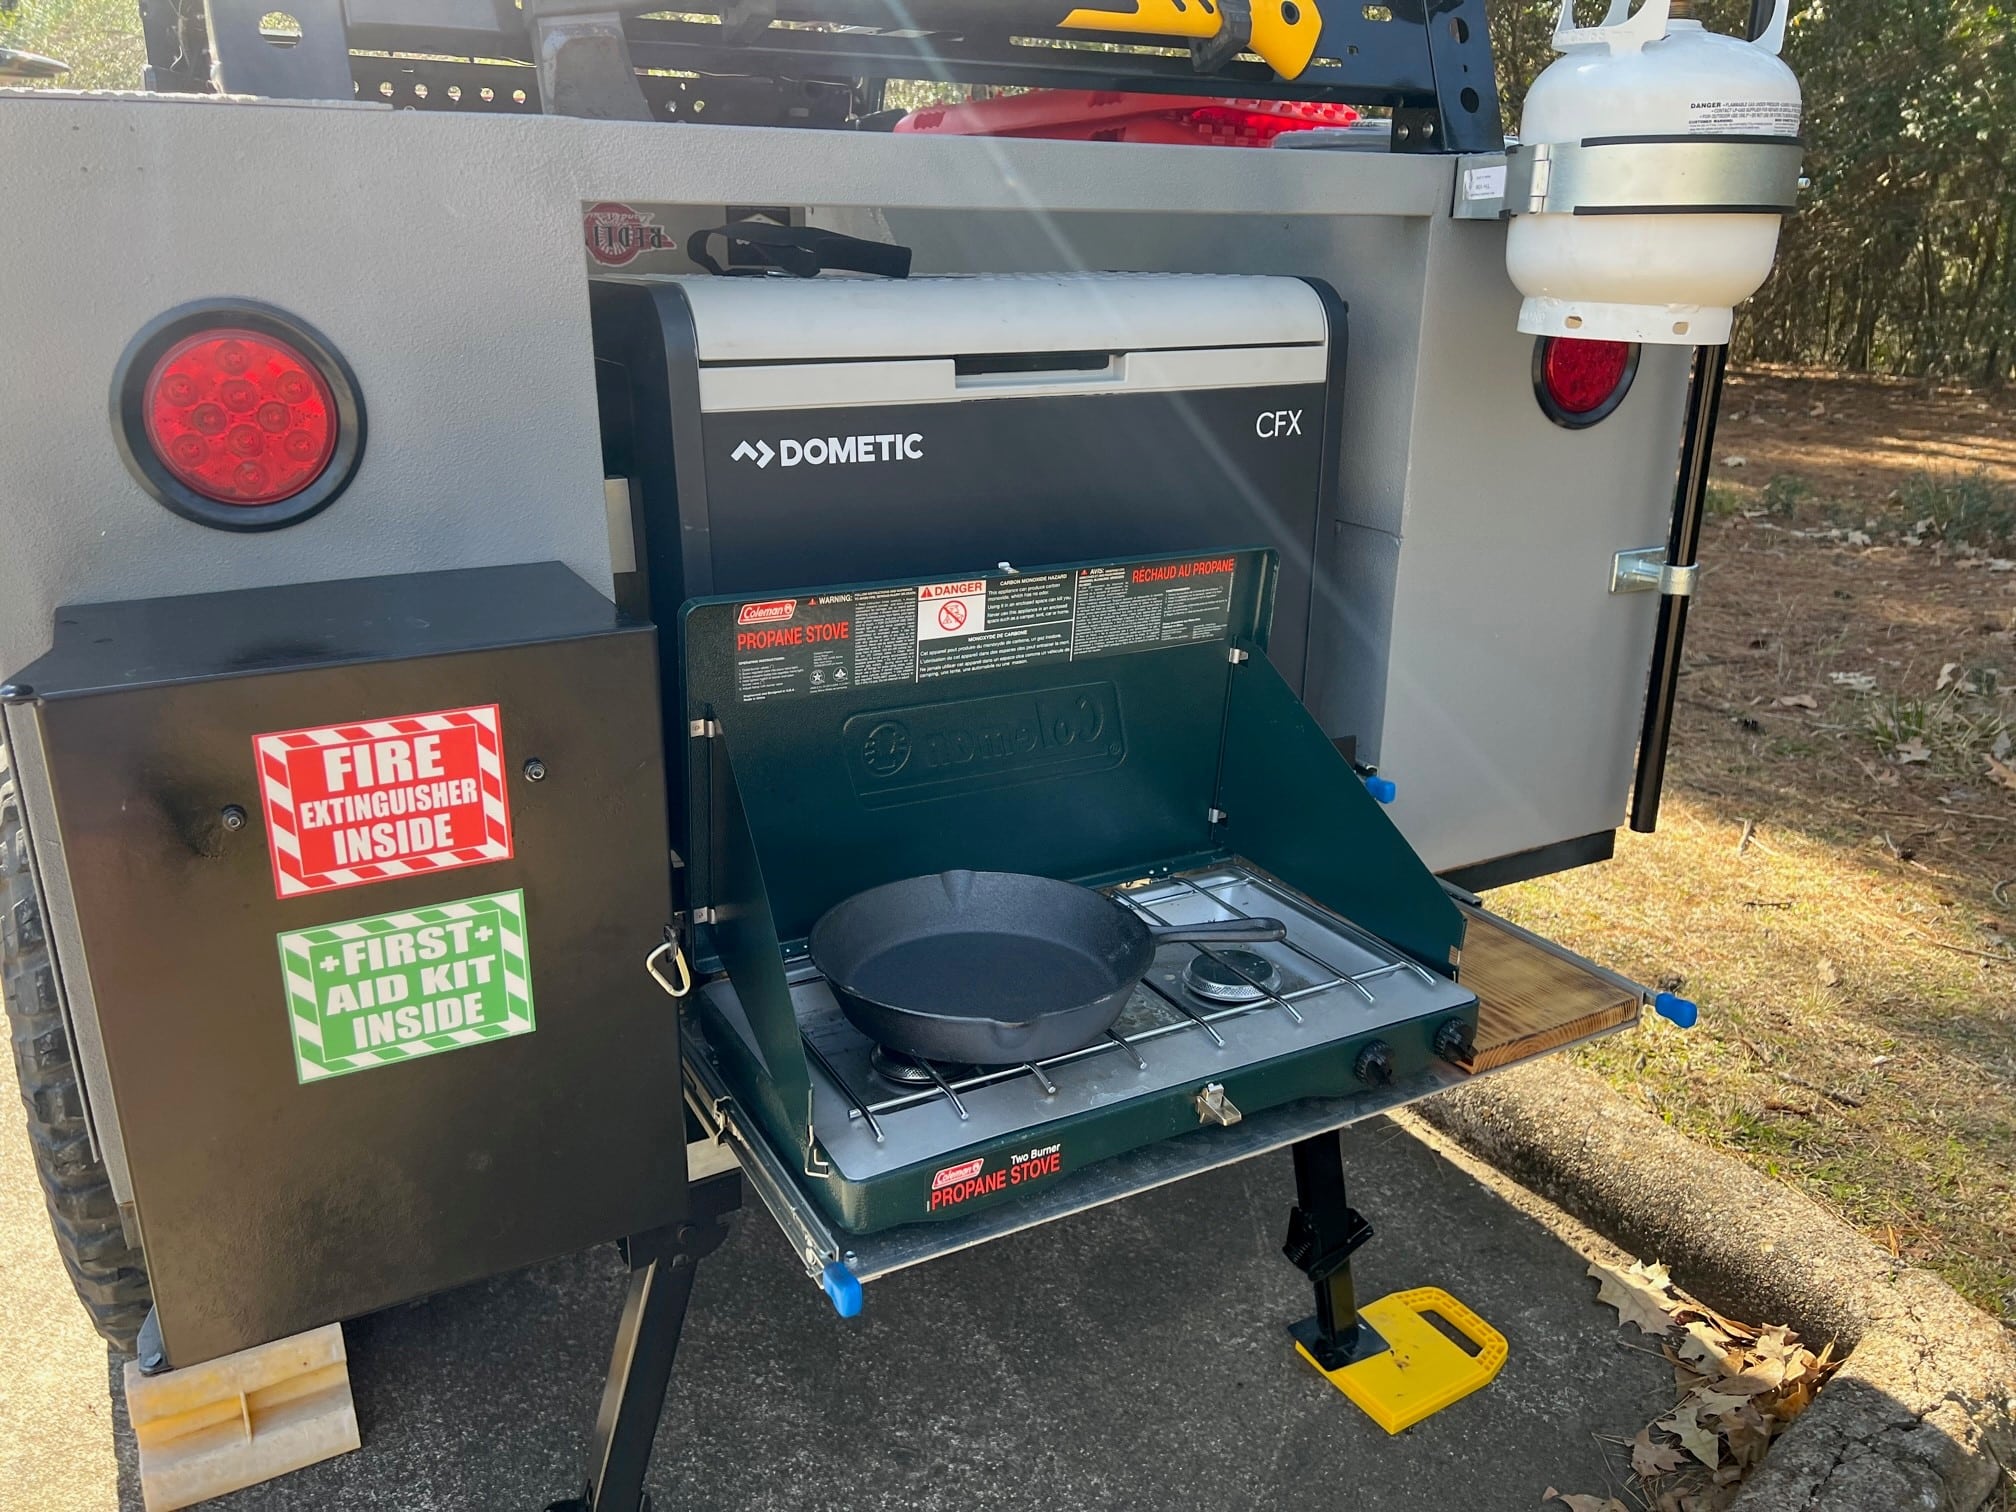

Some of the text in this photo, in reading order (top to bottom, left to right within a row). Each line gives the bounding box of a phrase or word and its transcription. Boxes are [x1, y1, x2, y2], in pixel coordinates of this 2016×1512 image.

[1256, 410, 1302, 438] CFX
[780, 433, 924, 467] DOMETIC
[1178, 564, 1191, 578] AU
[1192, 558, 1234, 576] PROPANE
[819, 594, 853, 605] WARNING:
[935, 582, 982, 596] DANGER
[744, 606, 783, 619] Coleman
[738, 621, 849, 650] PROPANE STOVE
[322, 734, 444, 792] FIRE
[300, 778, 478, 830] EXTINGUISHER
[332, 814, 454, 865] INSIDE
[342, 920, 473, 976] FIRST
[326, 954, 496, 1016] AID KIT
[353, 992, 484, 1049] INSIDE
[1011, 1144, 1061, 1165] Two Burner
[932, 1153, 1060, 1210] PROPANE STOVE
[937, 1166, 974, 1182] Coleman
